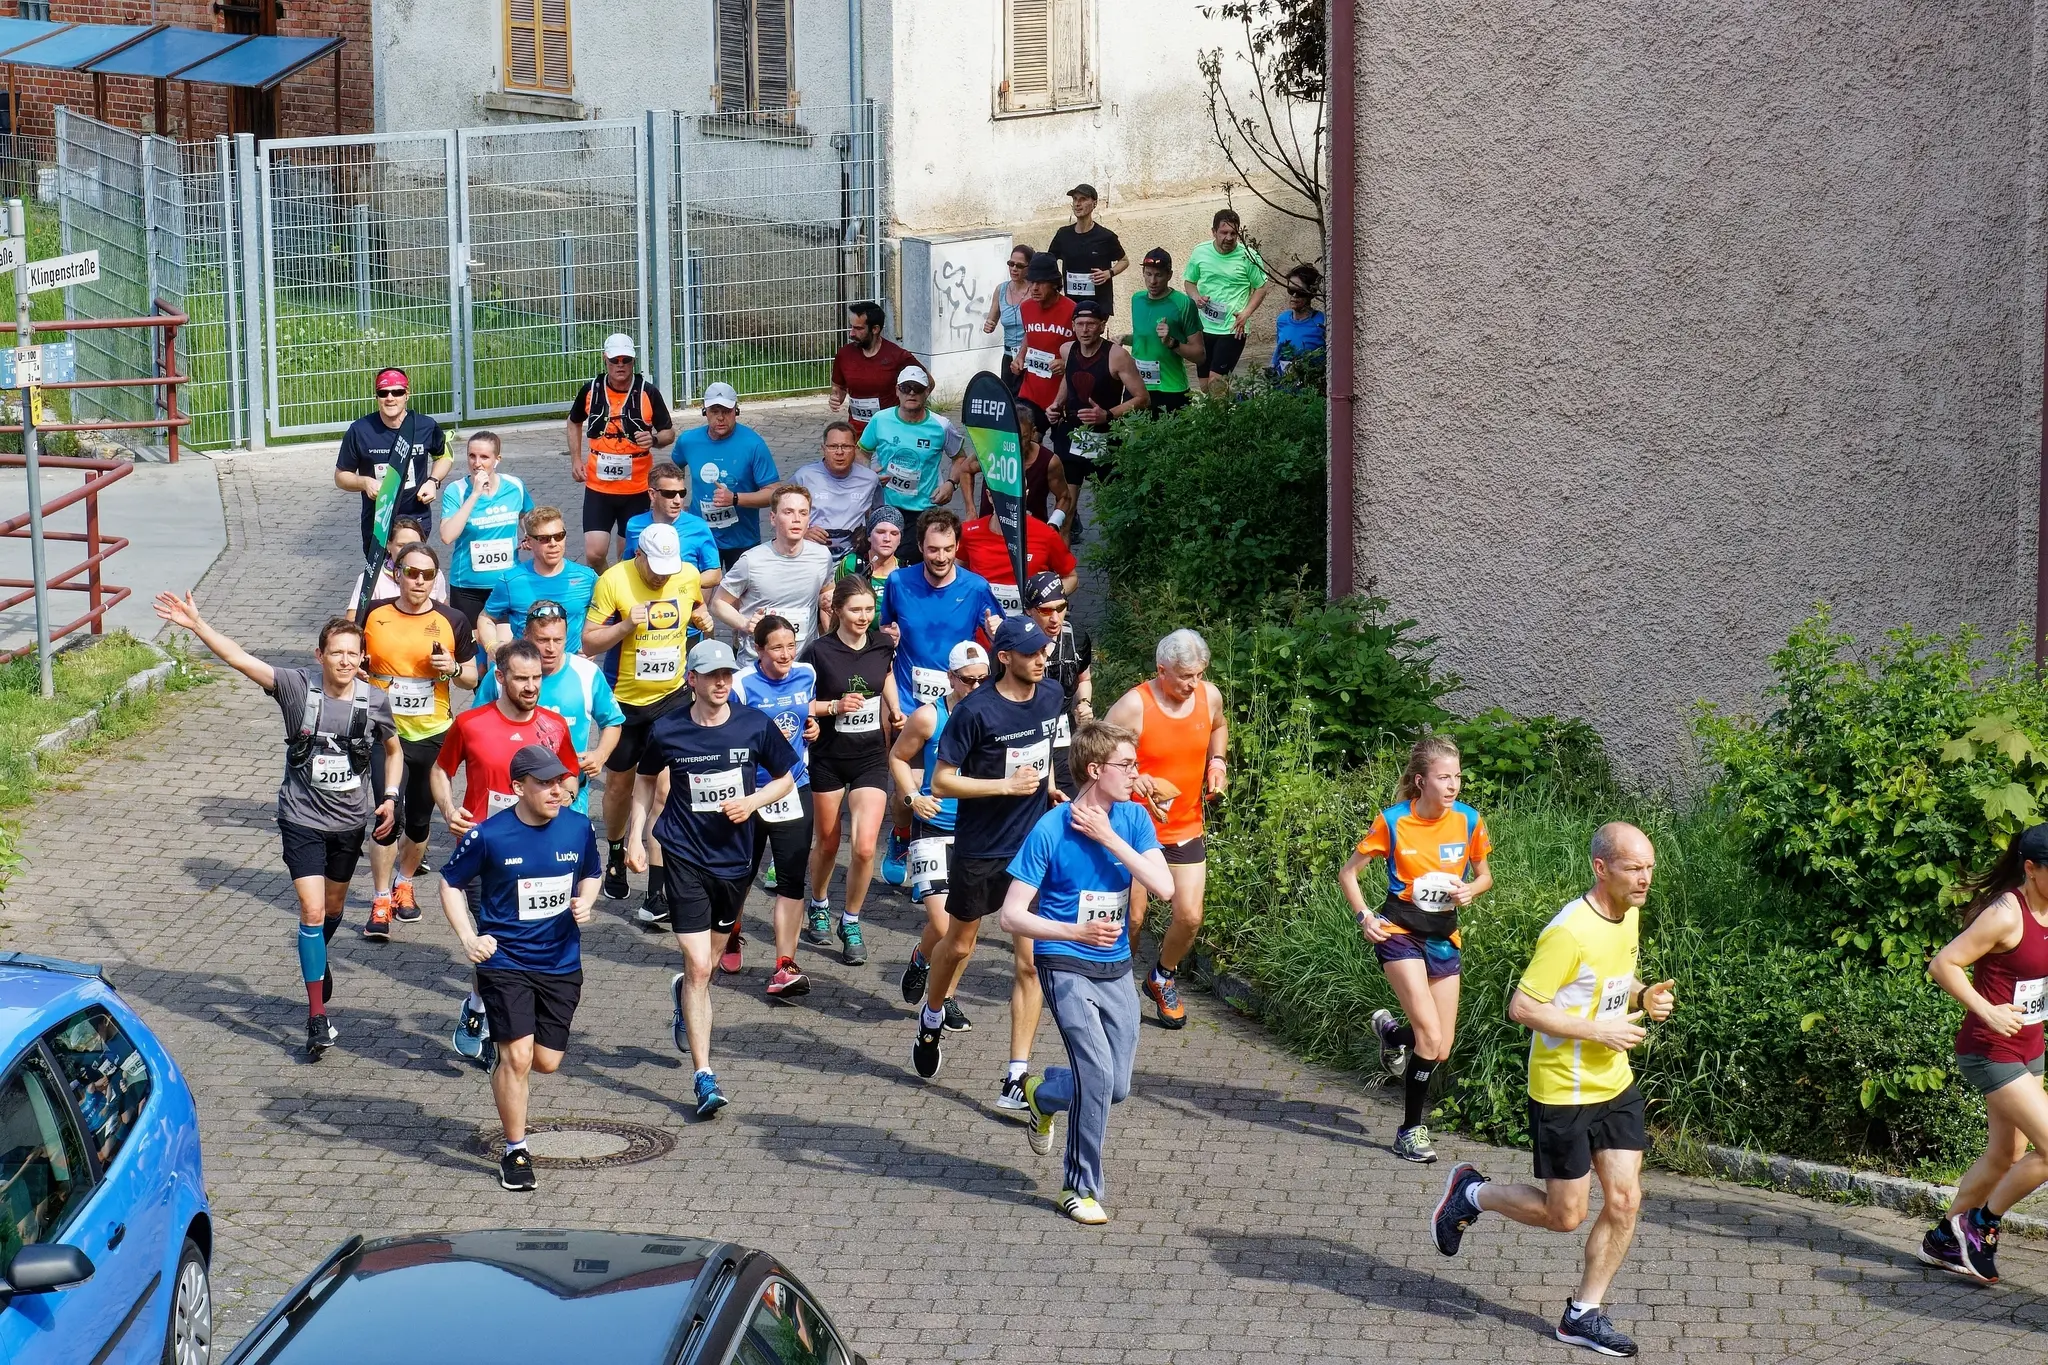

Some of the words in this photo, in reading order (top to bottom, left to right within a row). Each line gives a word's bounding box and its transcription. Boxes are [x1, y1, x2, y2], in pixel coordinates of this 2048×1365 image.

[31, 258, 96, 287] Klingenstraße
[1072, 283, 1088, 291] 857
[1028, 359, 1050, 372] 1842
[983, 399, 1006, 421] cep
[1003, 441, 1016, 453] SUB
[603, 465, 624, 476] 445
[987, 453, 1018, 485] 2:00
[891, 476, 911, 489] 676
[705, 510, 732, 522] 1674
[478, 553, 508, 564] 2050
[998, 599, 1018, 609] 90
[642, 661, 675, 673] 2478
[917, 684, 947, 697] 1282
[395, 696, 428, 708] 1327
[843, 713, 874, 725] 1643
[1000, 729, 1036, 741] INTERSPORT
[680, 755, 721, 763] INTERSPORT
[700, 786, 736, 802] 1059
[505, 857, 523, 865] JAKO
[556, 851, 579, 863] Lucky
[528, 893, 566, 909] 1388
